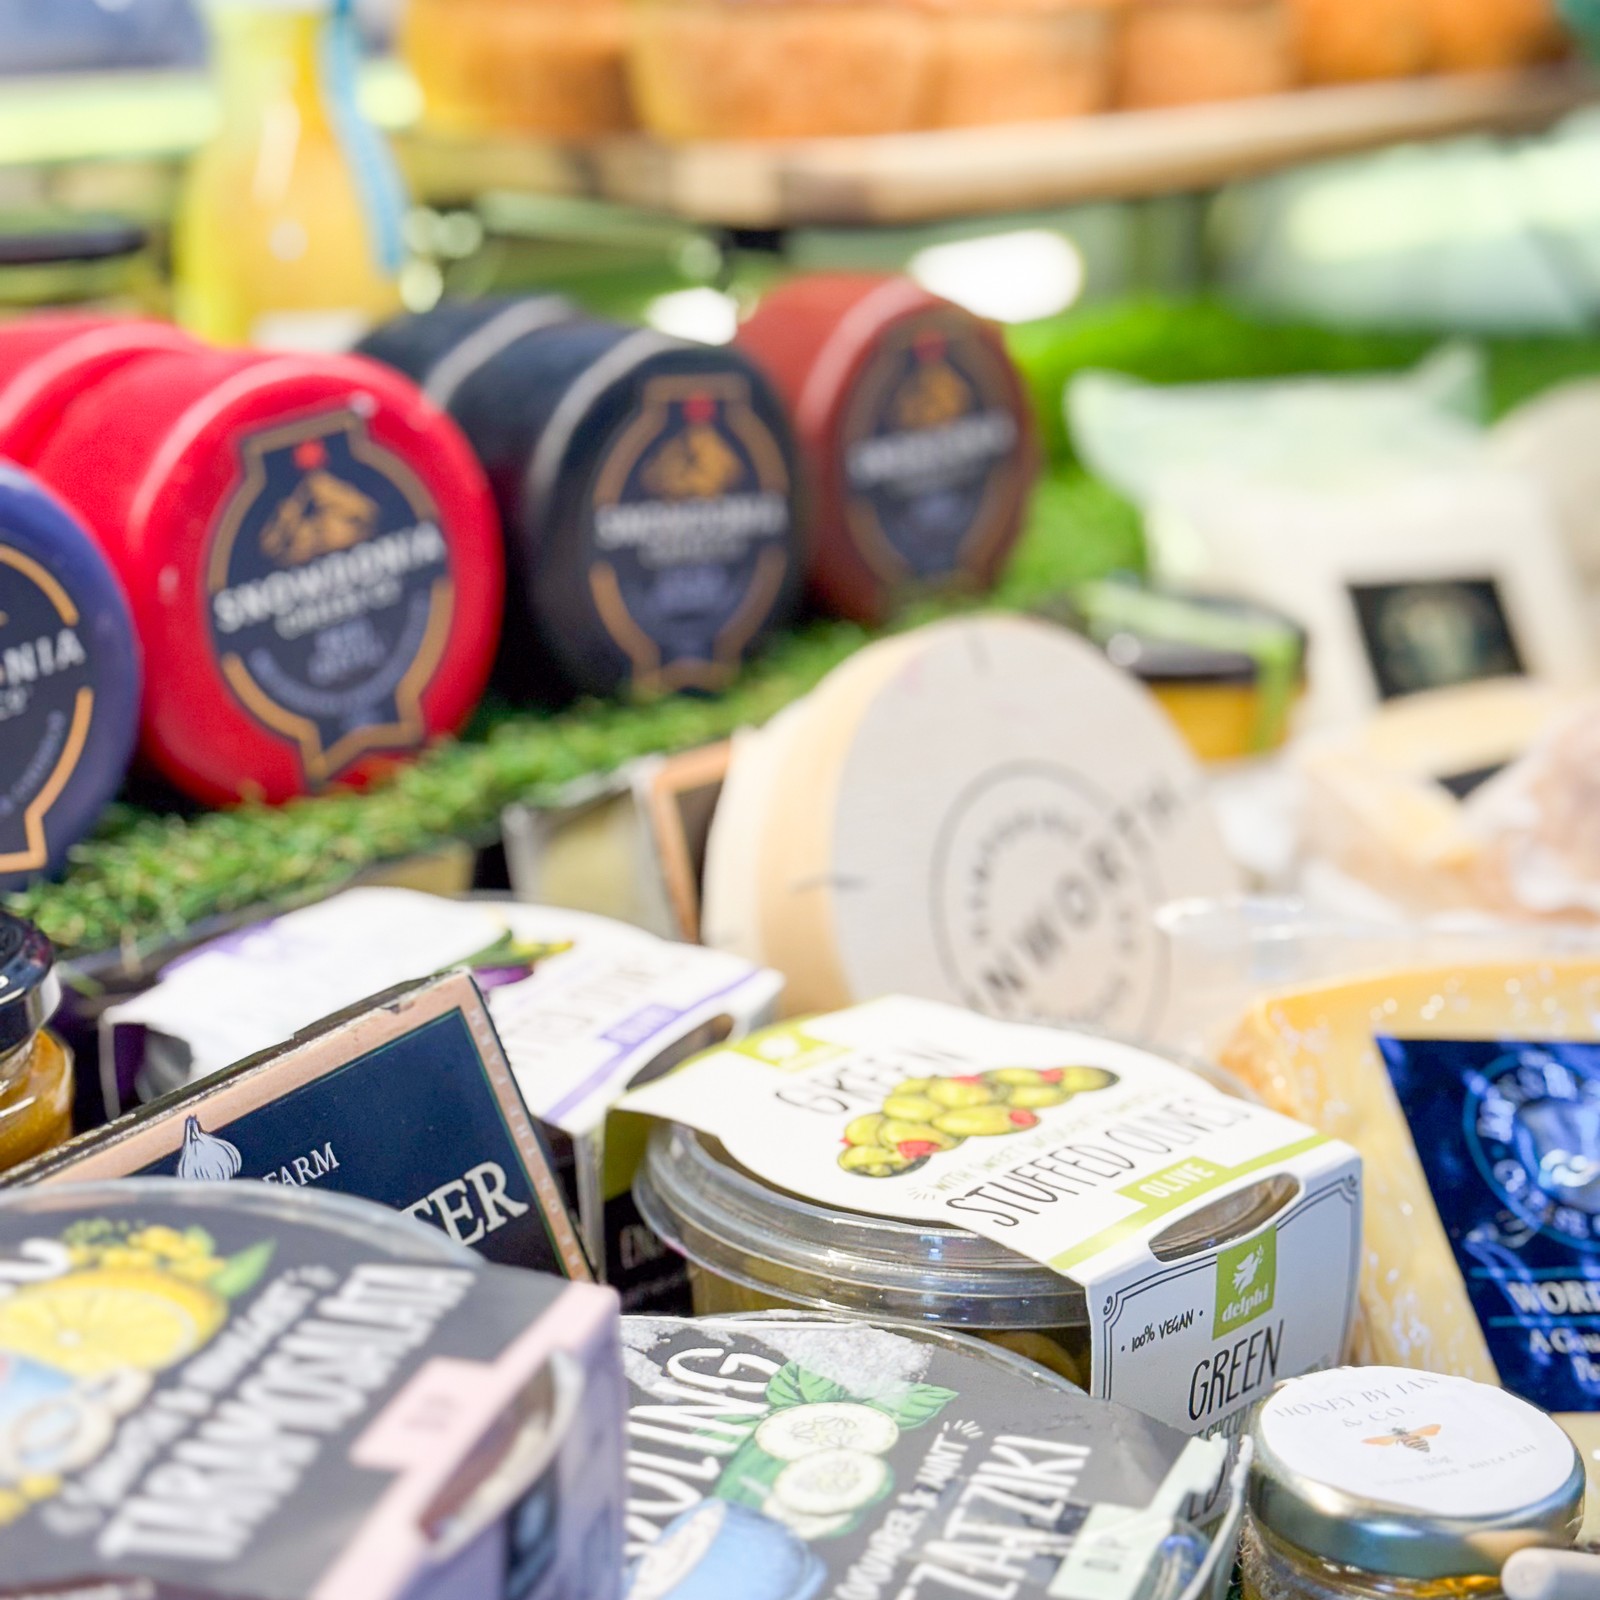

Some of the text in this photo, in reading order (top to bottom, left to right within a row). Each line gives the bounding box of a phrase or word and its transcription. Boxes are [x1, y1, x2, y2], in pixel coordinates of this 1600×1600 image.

[0, 629, 86, 687] NIA
[945, 1145, 1136, 1227] STUFFED
[1139, 1163, 1216, 1198] OLIVE
[1222, 1283, 1269, 1323] delphi
[1132, 1309, 1194, 1352] 100% VEGAN
[1188, 1318, 1284, 1421] GREEN
[1361, 1386, 1392, 1403] BY
